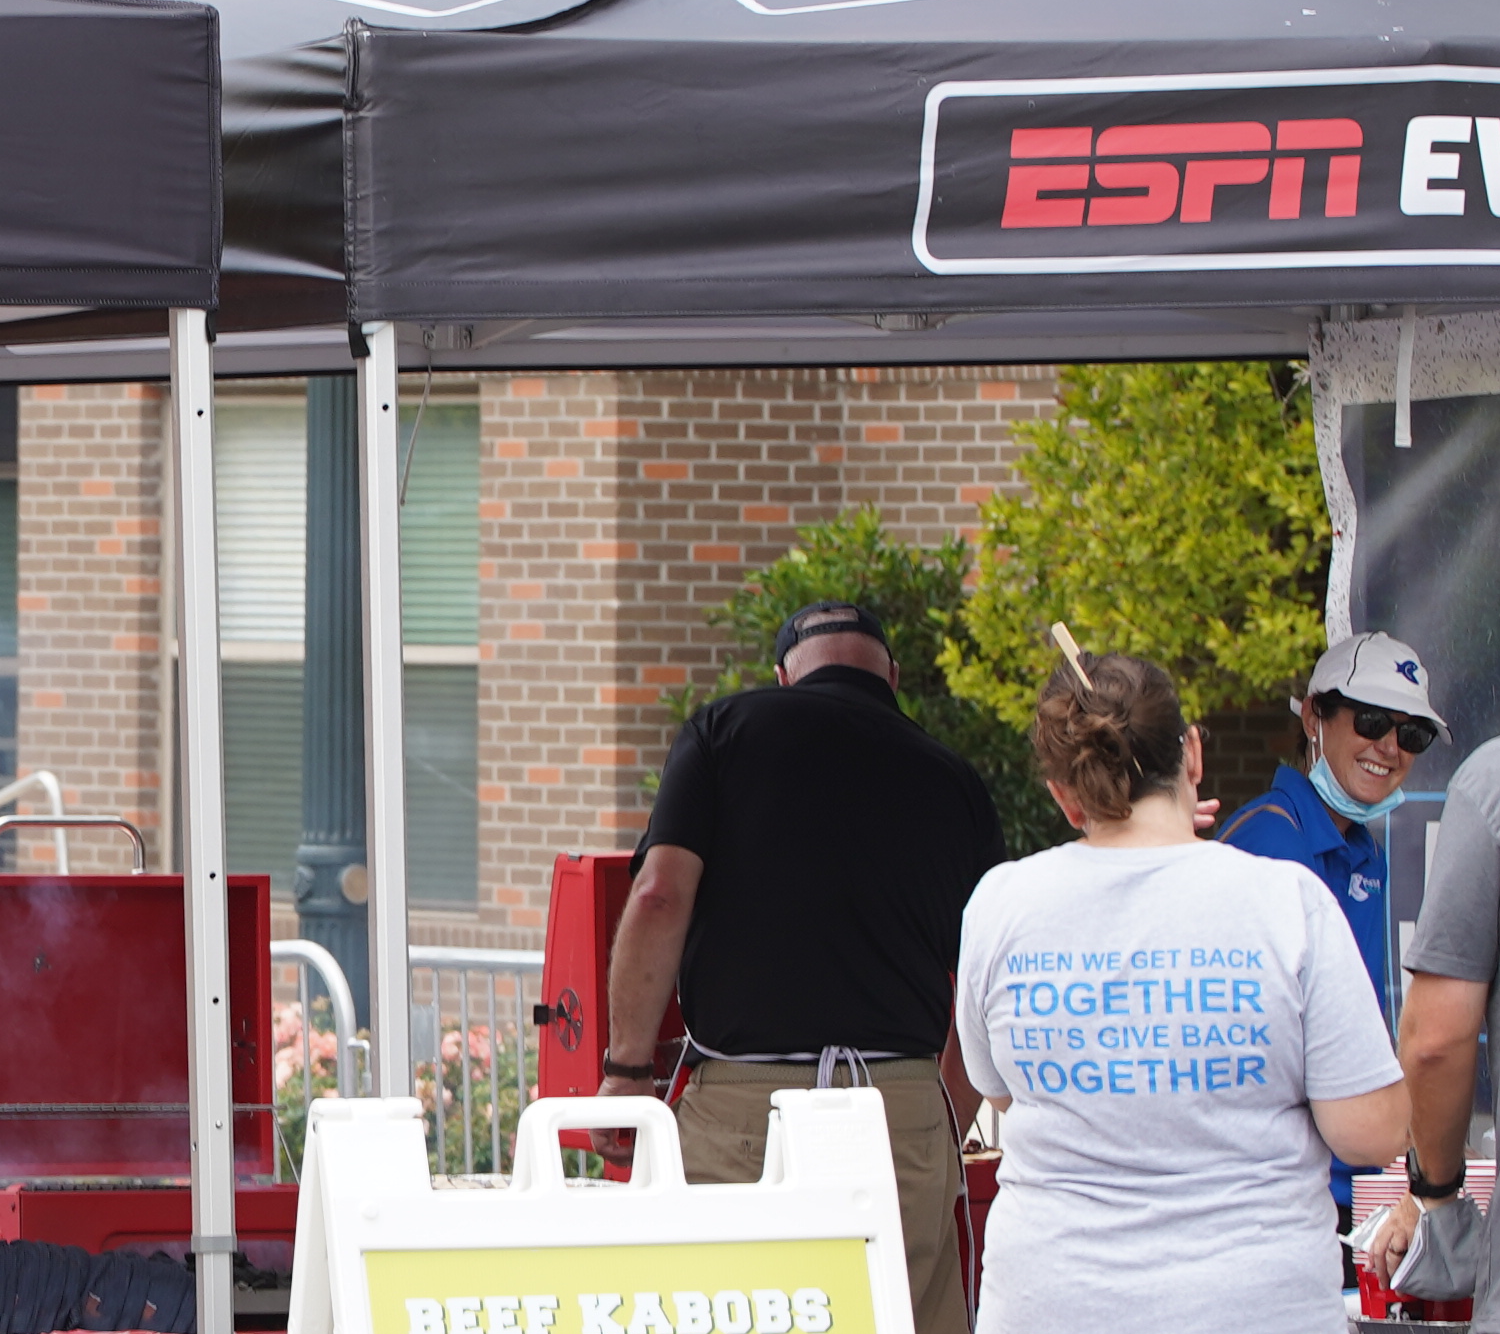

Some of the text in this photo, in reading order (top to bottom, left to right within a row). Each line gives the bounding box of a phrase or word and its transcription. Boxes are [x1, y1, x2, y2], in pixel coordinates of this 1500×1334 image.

[1000, 117, 1364, 229] ESPN
[1004, 948, 1263, 975] WHEN WE GET BACK
[1005, 978, 1265, 1018] TOGETHER
[1010, 1023, 1272, 1051] LET'S GIVE BACK
[1014, 1055, 1269, 1094] TOGETHER
